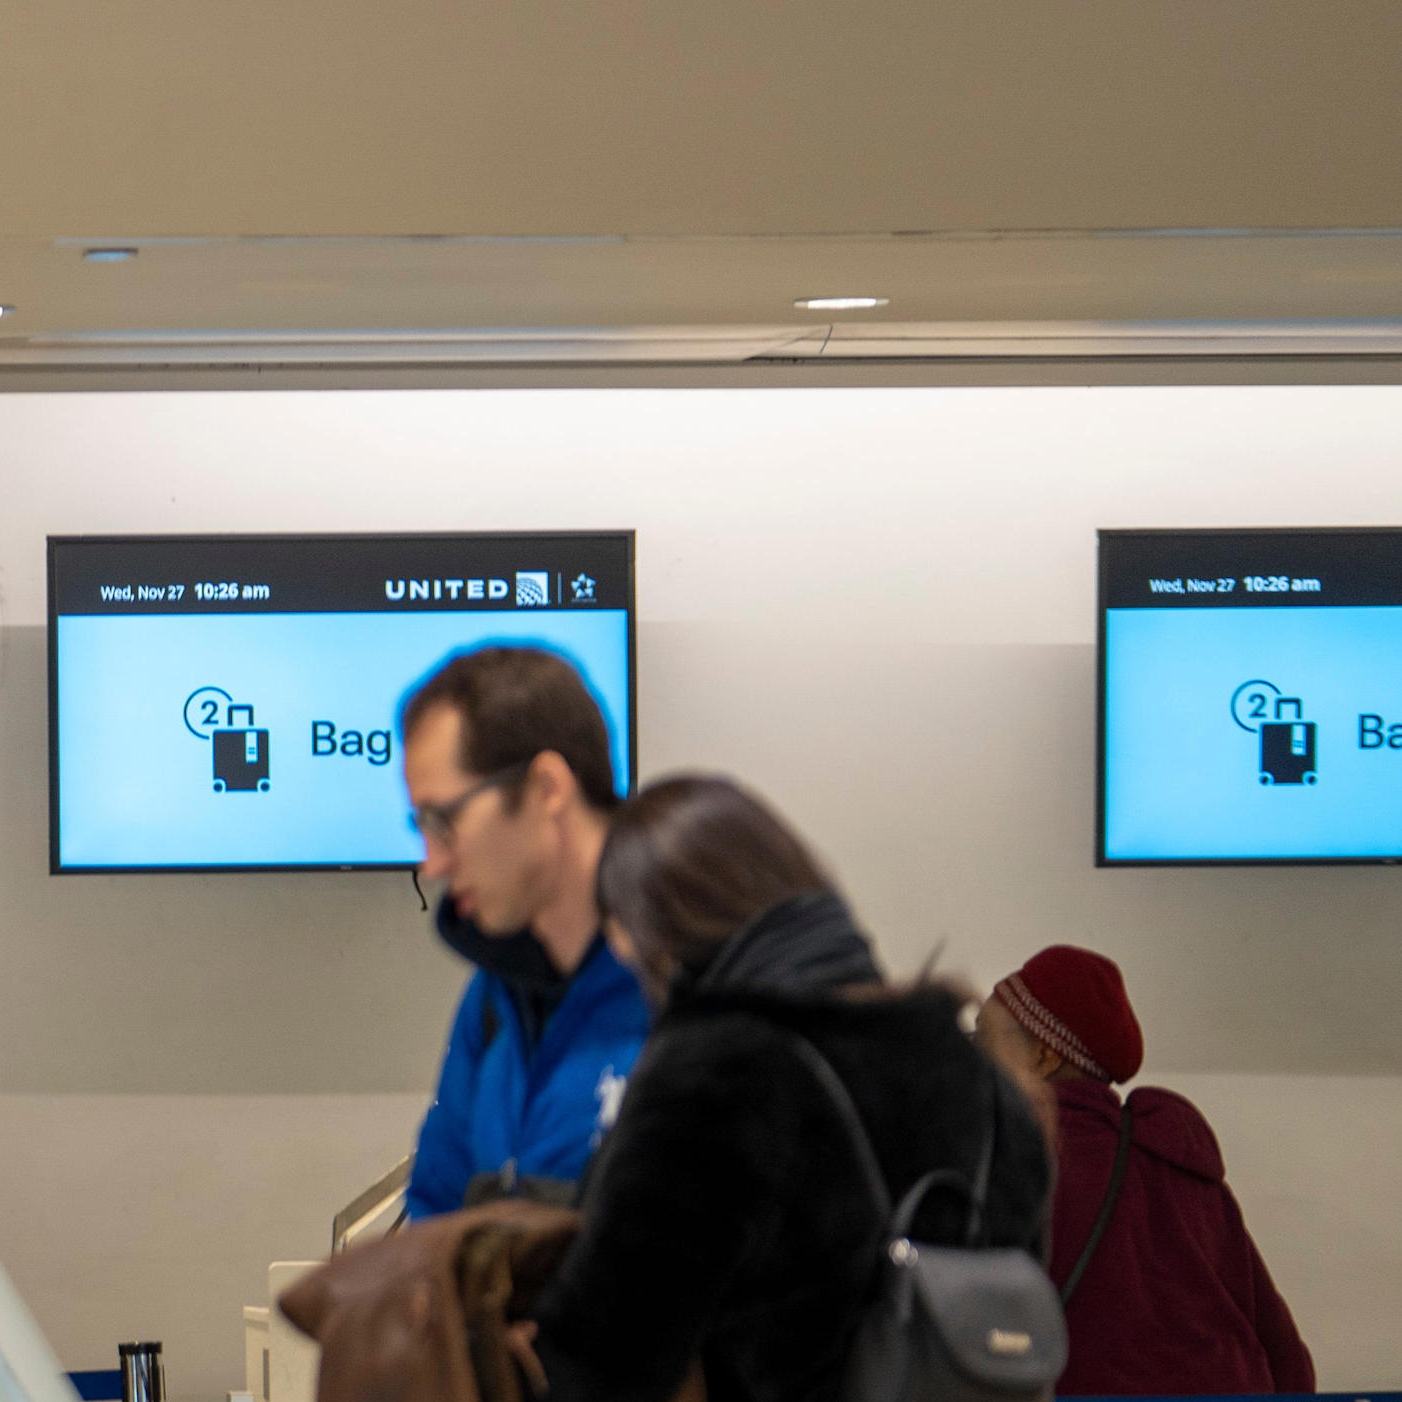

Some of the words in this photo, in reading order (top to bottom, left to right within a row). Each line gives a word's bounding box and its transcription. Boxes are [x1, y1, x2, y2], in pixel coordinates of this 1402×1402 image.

[194, 582, 239, 600] 10:26
[241, 584, 270, 600] am
[385, 578, 508, 600] UNITED
[1149, 578, 1186, 594] Wed,
[1187, 578, 1216, 592] Nov
[1217, 577, 1236, 592] 27
[1243, 575, 1289, 592] 10:26
[1291, 577, 1321, 592] am
[100, 584, 134, 602] Wed,
[138, 584, 166, 601] Nov
[167, 584, 185, 601] 27
[1358, 713, 1402, 750] Ba
[311, 721, 392, 766] Bag
